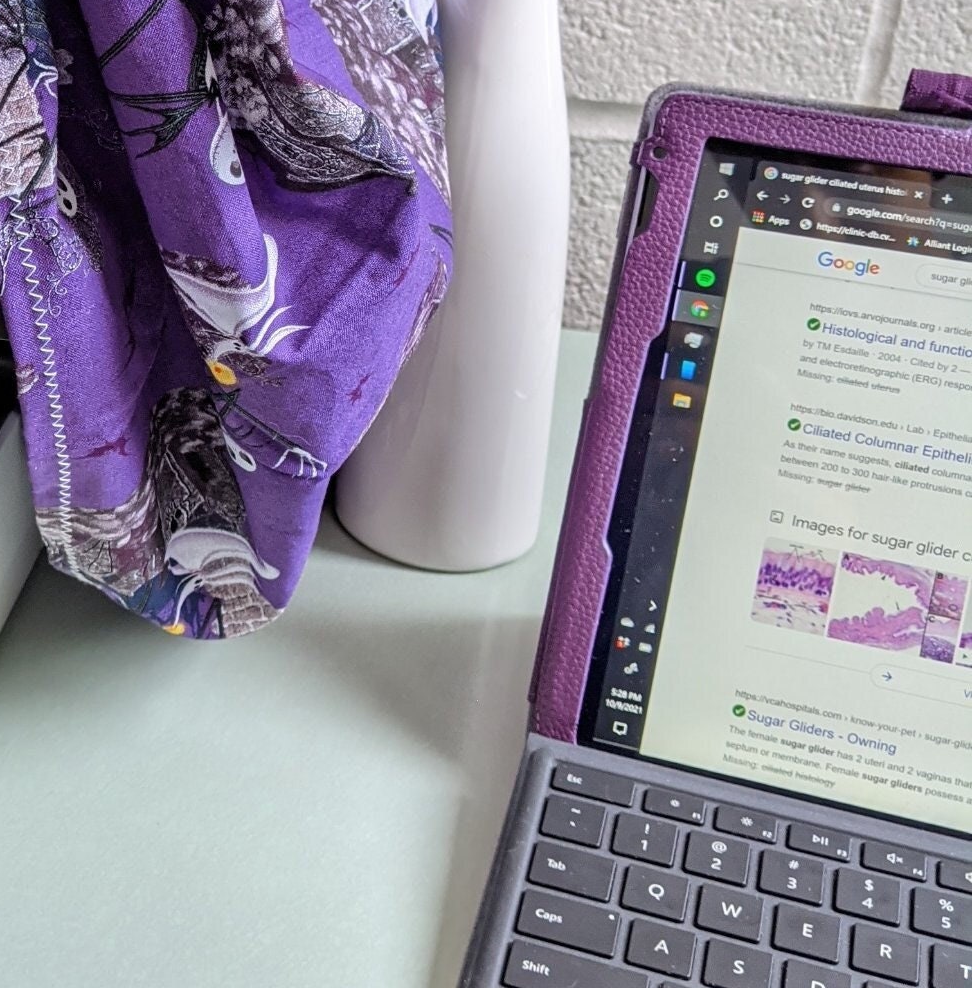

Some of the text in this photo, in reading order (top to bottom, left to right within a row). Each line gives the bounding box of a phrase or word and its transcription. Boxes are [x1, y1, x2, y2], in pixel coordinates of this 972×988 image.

[781, 171, 804, 184] sugar
[804, 174, 829, 187] glider
[829, 178, 857, 190] ciliated
[858, 182, 884, 195] uterus
[768, 215, 790, 227] Apps
[924, 238, 951, 251] Alliant
[817, 251, 958, 285] Google sugar
[822, 322, 897, 345] Histological
[900, 338, 926, 350] and
[803, 338, 814, 349] by
[817, 341, 831, 351] TM
[878, 351, 901, 363] 2004
[910, 357, 934, 369] Cited
[937, 362, 949, 372] by
[951, 364, 958, 373] 2
[797, 368, 832, 384] Missing:
[800, 354, 817, 364] and
[819, 357, 910, 381] electroretinographic
[912, 373, 942, 388] (ERG)
[790, 403, 898, 430] https://bio.davidson.edu
[906, 424, 924, 435] Lab
[803, 423, 851, 442] Ciliated
[855, 432, 919, 454] Columnar
[783, 439, 795, 449] As
[798, 441, 818, 452] their
[820, 446, 845, 458] name
[895, 460, 929, 474] ciliated
[778, 468, 814, 484] Missing:
[780, 454, 962, 497] between 200 to 300 hair-like protrusions
[792, 514, 959, 559] Images for sugar glider
[735, 689, 842, 720] https://vcahospitals.com
[850, 716, 916, 738] know-your-pet
[747, 709, 897, 755] Sugar Gliders Owning
[729, 724, 747, 736] The
[748, 729, 778, 743] female
[780, 738, 806, 750] sugar
[808, 744, 834, 757] glider
[837, 750, 853, 762] has
[856, 754, 863, 763] 2
[865, 756, 885, 770] uteri
[887, 762, 904, 774] and
[907, 766, 914, 775] 2
[916, 769, 952, 784] vaginas
[566, 773, 583, 785] Esc
[725, 741, 758, 755] septum
[760, 748, 770, 756] or
[825, 763, 859, 779] Female
[862, 772, 888, 787] sugar
[890, 778, 923, 793] gliders
[925, 787, 963, 803] possess
[641, 839, 648, 851] 1
[711, 840, 728, 854] @
[547, 858, 567, 871] Tab
[711, 858, 722, 870] 2
[913, 868, 924, 877] F4
[787, 877, 798, 890] 3
[648, 884, 665, 901] Q
[721, 902, 743, 918] W
[862, 897, 874, 909] 4
[939, 899, 954, 912] %
[535, 908, 563, 924] Caps
[941, 917, 951, 929] 5
[802, 923, 814, 938] E
[654, 939, 669, 955] A
[880, 944, 893, 960] R
[522, 960, 550, 976] Shift
[733, 960, 745, 975] S
[960, 964, 972, 979] T
